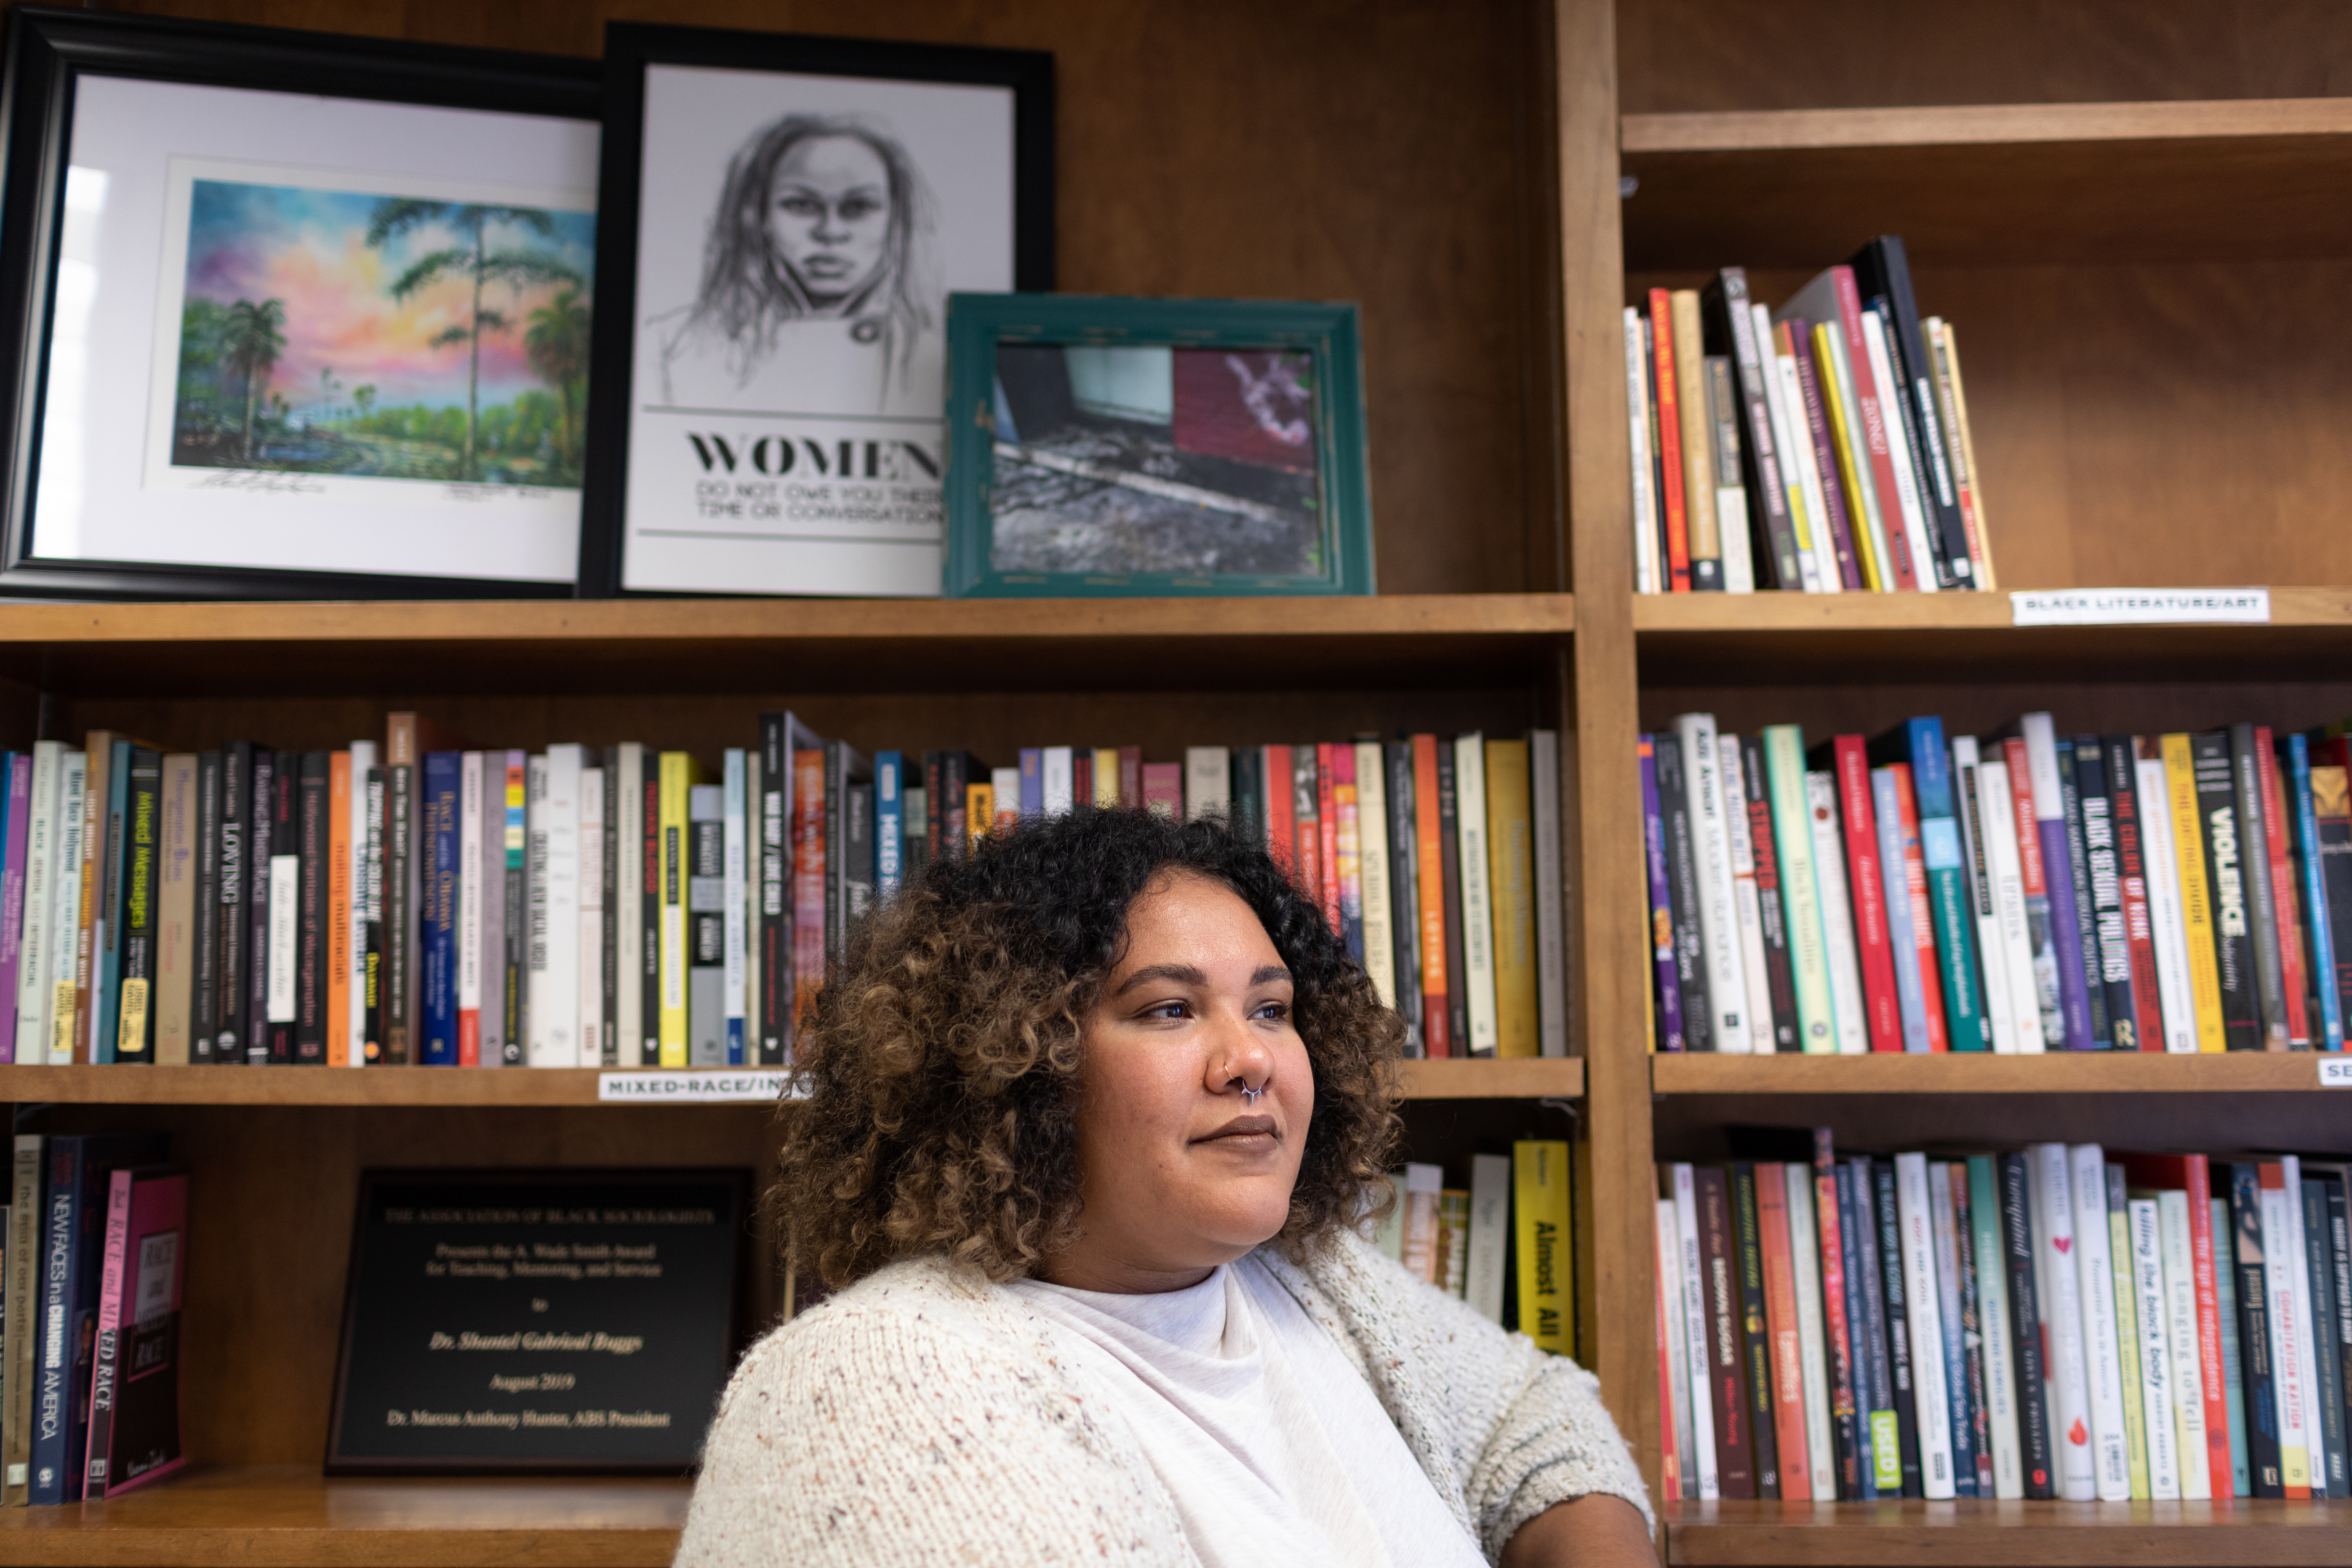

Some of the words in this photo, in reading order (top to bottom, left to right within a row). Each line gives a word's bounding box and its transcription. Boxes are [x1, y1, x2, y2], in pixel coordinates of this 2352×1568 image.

[687, 431, 940, 479] WOMEN
[2026, 596, 2088, 611] BLACK
[135, 792, 155, 843] Mixed
[2082, 797, 2113, 849] BLACK
[220, 823, 242, 903] LOVING
[1747, 801, 1777, 890] STRIPPED
[2119, 824, 2140, 875] COLOR
[127, 847, 151, 928] Messages
[2088, 850, 2121, 910] SEXUAL
[2124, 877, 2145, 898] OF
[2207, 806, 2249, 937] VIOLENCE
[2127, 902, 2150, 940] KINK
[2097, 911, 2129, 982] POLITICS
[52, 1195, 71, 1233] NEW
[2135, 1206, 2156, 1256] killing
[50, 1234, 69, 1281] FACES
[106, 1218, 124, 1263] RACE
[1536, 1221, 1557, 1295] Almost
[2194, 1236, 2211, 1258] the
[104, 1269, 119, 1295] and
[1711, 1258, 1730, 1313] BROWN
[2143, 1263, 2159, 1289] the
[2194, 1261, 2213, 1288] age
[2199, 1289, 2216, 1305] of
[45, 1305, 66, 1369] CHANGING
[98, 1302, 119, 1361] MIXED
[429, 1332, 455, 1350] Dr.
[1538, 1308, 1560, 1335] All
[1716, 1315, 1734, 1366] SUGAR
[2146, 1296, 2162, 1339] black
[2170, 1281, 2196, 1361] Longing
[1777, 1330, 1803, 1402] families
[2147, 1346, 2166, 1388] body
[2200, 1307, 2223, 1401] independence
[2279, 1290, 2297, 1378] COHABITATION
[2288, 1384, 2302, 1430] NATION
[94, 1365, 115, 1412] RACE
[489, 1374, 539, 1393] August
[540, 1373, 576, 1390] 2019
[2182, 1371, 2196, 1388] to
[40, 1370, 60, 1441] AMERICA
[387, 1410, 409, 1426] Dr.
[1874, 1417, 1898, 1472] USED
